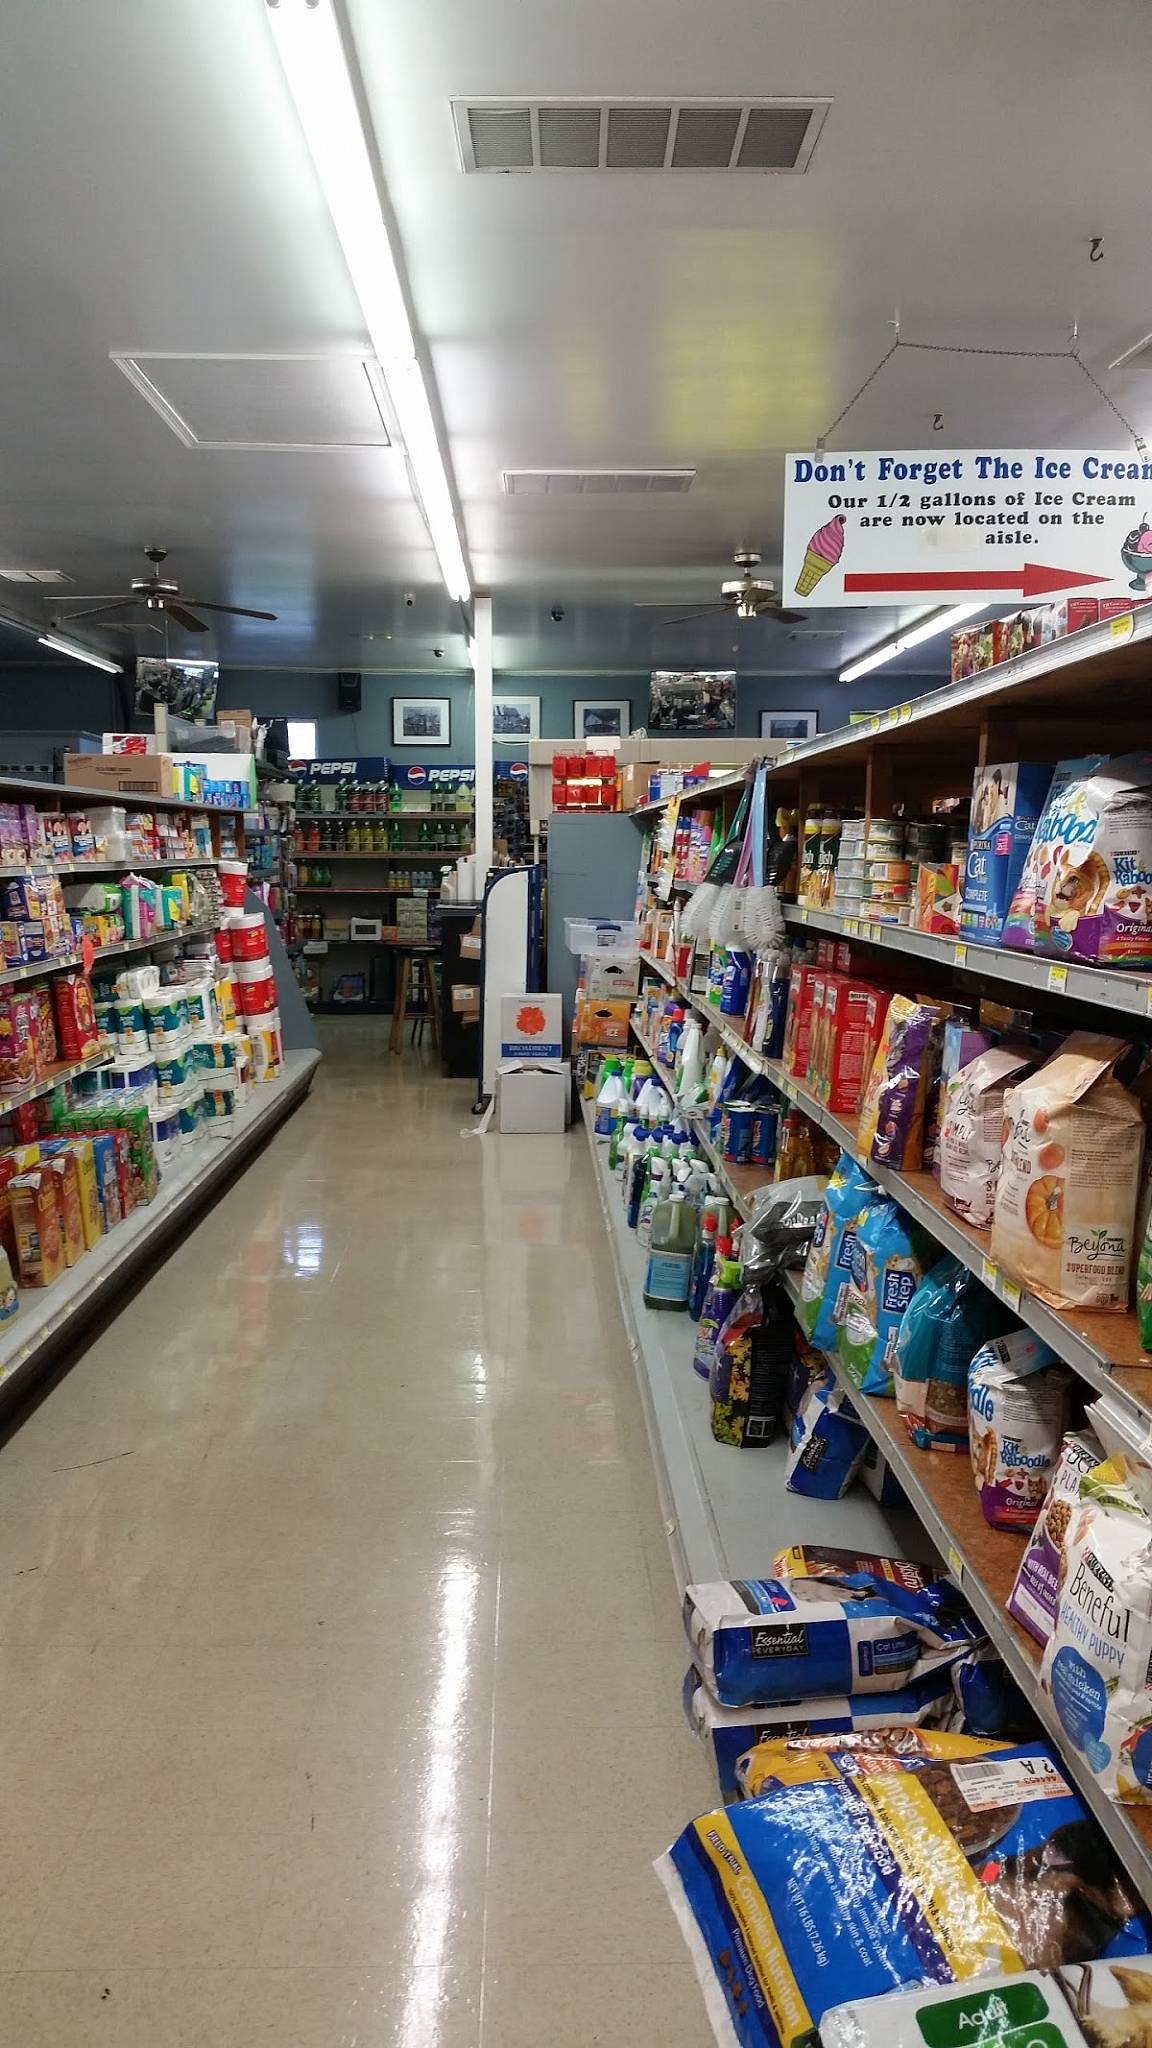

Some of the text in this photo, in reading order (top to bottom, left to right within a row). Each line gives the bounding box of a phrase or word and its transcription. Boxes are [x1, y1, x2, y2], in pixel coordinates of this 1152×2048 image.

[794, 459, 866, 483] Don't
[878, 457, 963, 484] Forget
[975, 456, 1023, 479] The
[1034, 456, 1071, 479] Ice
[828, 492, 1136, 510] Our 1/2 gallons of Ice Cream
[860, 511, 1105, 527] are now located on the
[985, 531, 1039, 545] aisle.
[309, 761, 358, 775] PEPSI
[427, 769, 475, 782] PEPSI
[967, 852, 987, 878] Cat
[1113, 857, 1136, 872] Kit
[1112, 869, 1152, 887] Kaboo
[839, 1232, 855, 1267] Fresh
[1068, 1236, 1126, 1261] Beyond
[884, 1272, 900, 1309] Fresh
[897, 1275, 914, 1308] Step
[1002, 1440, 1020, 1456] Kit
[1006, 1497, 1038, 1511] Original
[1069, 1560, 1130, 1643] Beneful
[755, 1628, 805, 1648] Essential
[752, 1645, 805, 1655] EVERYDAY
[1088, 1631, 1125, 1669] PUPPY
[785, 1877, 800, 1894] NET
[790, 1891, 805, 1906] WT
[797, 1905, 809, 1918] 16
[801, 1915, 817, 1933] LBS
[730, 1928, 750, 1966] Premium
[744, 1963, 758, 1987] Dog
[814, 1950, 831, 1969] kg)
